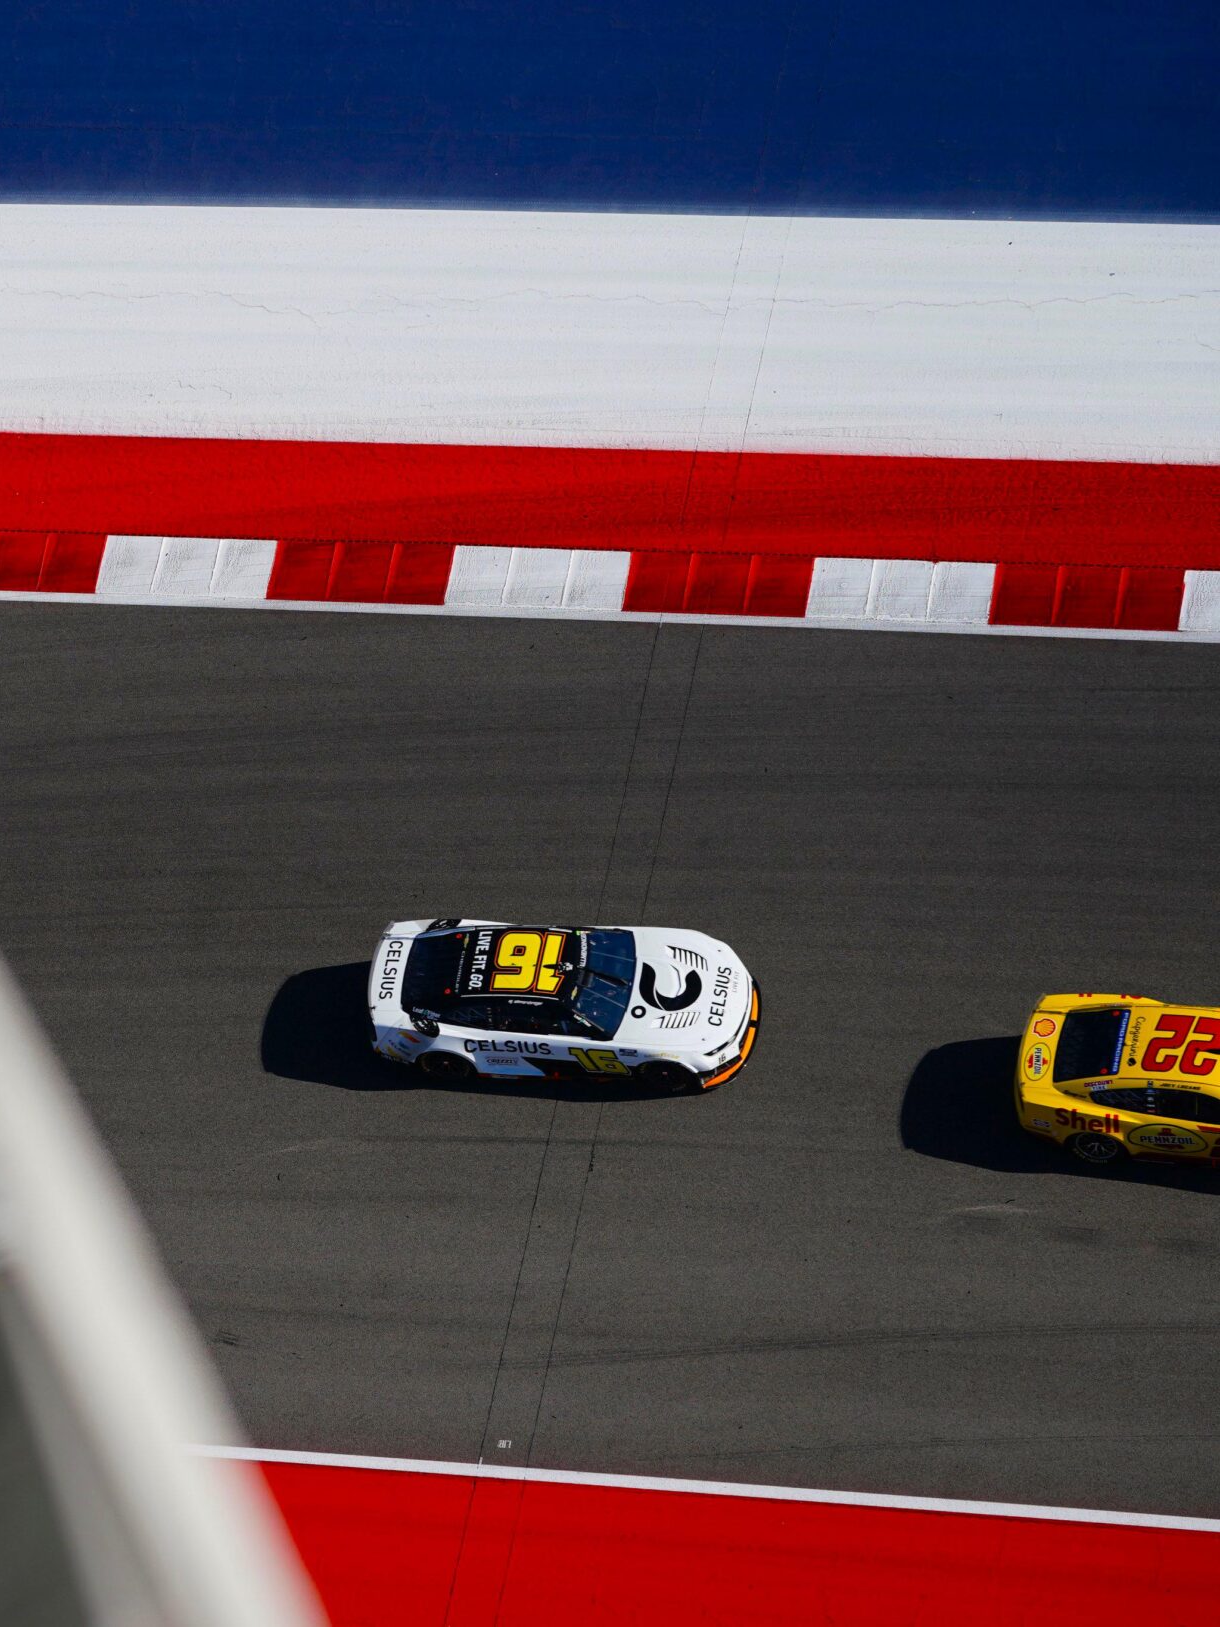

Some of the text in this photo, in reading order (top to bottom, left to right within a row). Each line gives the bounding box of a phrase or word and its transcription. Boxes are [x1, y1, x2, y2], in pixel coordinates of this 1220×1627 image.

[378, 940, 404, 1000] CELSIUS
[454, 951, 466, 993] CHEVROLET
[467, 930, 493, 990] LIVE. FIT. GO.
[489, 930, 567, 995] 16
[708, 966, 732, 1027] CELSIUS
[464, 1039, 552, 1055] CELSIUS
[568, 1046, 633, 1077] 16
[718, 1053, 727, 1065] 16
[1033, 1047, 1043, 1075] PENNZOIL
[1112, 1012, 1130, 1072] FORD RACING
[1141, 1013, 1220, 1077] 22
[1055, 1107, 1120, 1133] Shell
[1139, 1135, 1196, 1146] PENNZOIL
